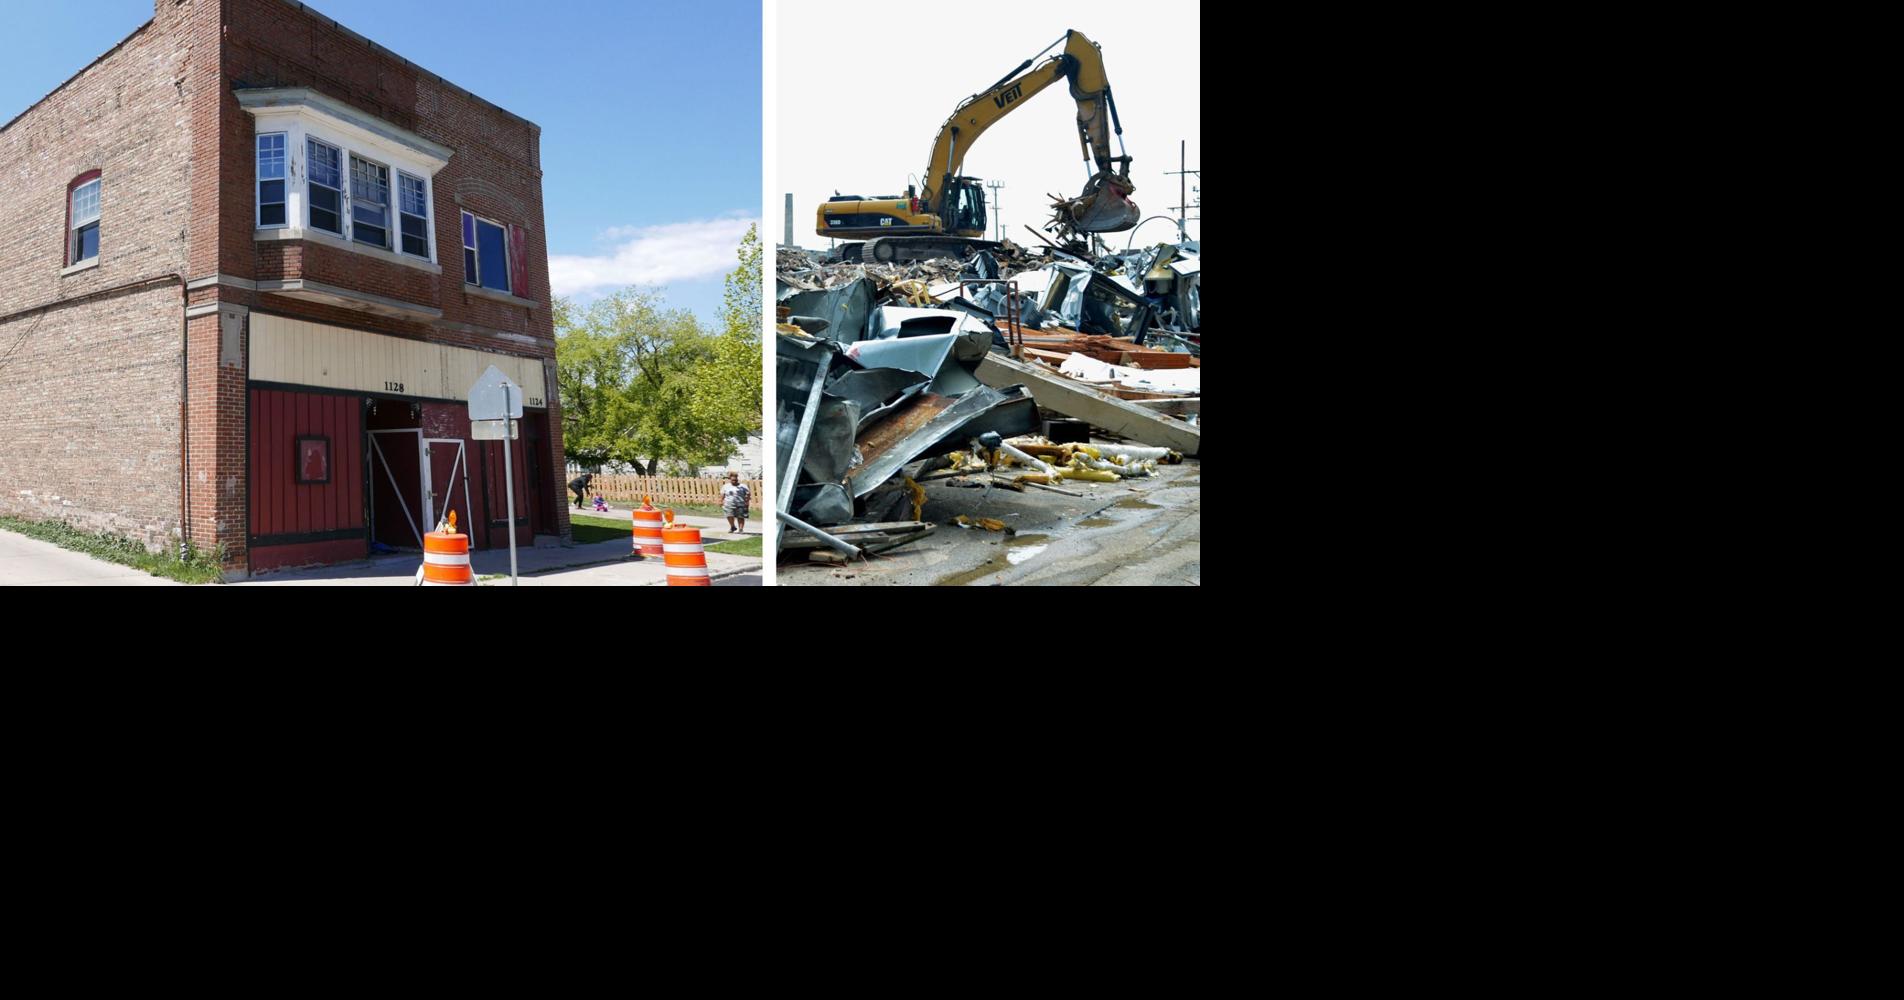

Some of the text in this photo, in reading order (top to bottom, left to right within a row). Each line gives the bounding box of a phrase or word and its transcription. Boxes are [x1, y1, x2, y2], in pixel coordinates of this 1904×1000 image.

[993, 82, 1023, 109] VEIT
[880, 217, 893, 226] CAT
[384, 381, 405, 393] 1128
[529, 397, 543, 406] 1124
